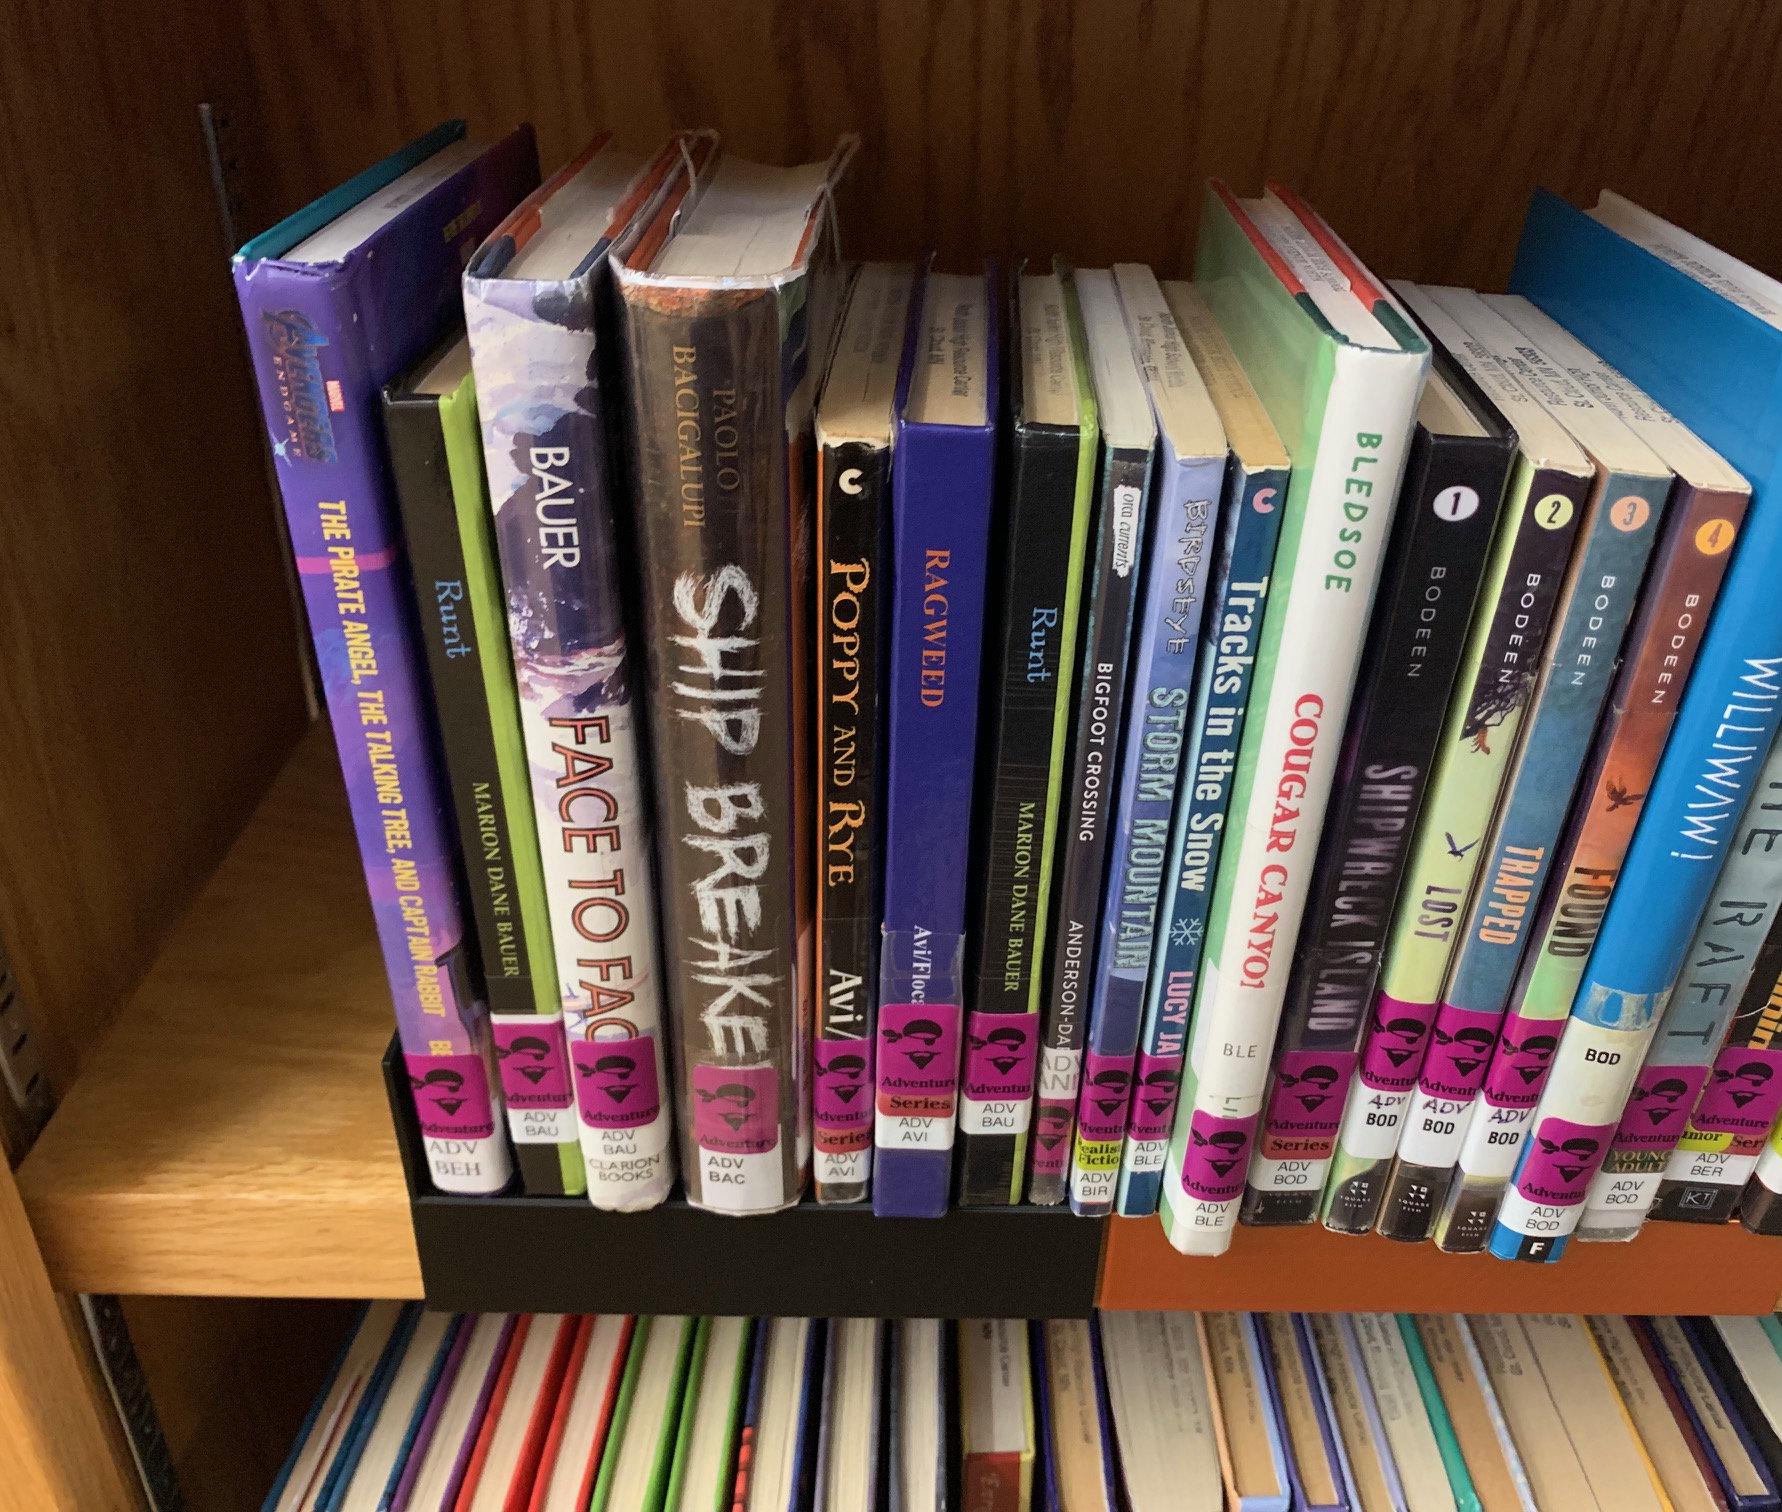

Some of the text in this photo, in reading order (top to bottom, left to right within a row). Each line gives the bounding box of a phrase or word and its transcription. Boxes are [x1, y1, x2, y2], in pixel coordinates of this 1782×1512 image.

[672, 344, 707, 528] BACIGALUPI
[712, 388, 741, 491] PAOLO
[529, 446, 581, 570] BAUER
[1450, 491, 1461, 516] 1
[1324, 432, 1383, 593] BLEDSOE
[1547, 502, 1560, 524] 2
[1623, 502, 1637, 525] 3
[1706, 526, 1722, 548] 4
[1165, 499, 1213, 655] BIRDSEYE
[435, 579, 472, 659] Runt
[1407, 566, 1446, 677] BODEEN
[1498, 572, 1541, 683] BODEEN
[920, 549, 951, 709] RAGWEED
[1570, 575, 1616, 686] BODEEN
[1026, 606, 1058, 684] Runt
[1651, 594, 1699, 704] BODEEN
[667, 564, 769, 756] SHIP
[828, 557, 870, 887] POPPY AND RYE
[1181, 576, 1269, 893] Tracks in the Snow
[318, 500, 446, 1017] THE PIRATE ANGEL, THE TALKING TREE, AND CAPTAIN RABBIT
[1079, 662, 1114, 842] BIGFOOT CROSSING
[1671, 657, 1782, 861] WILLIWAW!
[549, 714, 622, 854] FACE
[1112, 687, 1189, 970] STORM MOUNTAIN
[1240, 693, 1324, 989] COUGAR CANYO
[472, 782, 520, 978] MARION DANE BAUER
[1003, 801, 1036, 992] MARION DANE BAUER
[1307, 763, 1418, 1031] SHIPWRECK ISLAND
[1478, 845, 1545, 946] TRAPPED
[568, 868, 630, 943] TO
[1414, 884, 1463, 943] LOST
[1547, 866, 1618, 958] FOUND
[1667, 900, 1768, 1046] RAFT
[825, 968, 863, 1040] Avi/
[1162, 970, 1194, 1025] LUCY
[1223, 1044, 1258, 1058] BLE
[1584, 1048, 1621, 1065] BOD
[889, 1095, 951, 1109] Series
[982, 1103, 1017, 1113] ADV
[1368, 1094, 1406, 1109] ADV
[1422, 1098, 1471, 1114] ADV
[524, 1112, 557, 1122] ADV
[899, 1118, 933, 1128] ADV
[982, 1117, 1014, 1127] BAU
[1366, 1112, 1398, 1127] BOD
[1488, 1108, 1531, 1124] ADV
[525, 1125, 559, 1136] BAU
[602, 1130, 636, 1140] ADV
[1422, 1118, 1455, 1135] BOD
[902, 1131, 928, 1142] AVI
[1487, 1131, 1519, 1145] BOD
[429, 1141, 478, 1154] ADV
[603, 1144, 637, 1155] BAU
[1271, 1139, 1329, 1152] Series
[589, 1154, 660, 1171] CLARION
[708, 1156, 744, 1168] ADV
[824, 1153, 859, 1164] ADV
[1133, 1154, 1162, 1165] BLE
[1277, 1161, 1311, 1171] ADV
[1696, 1152, 1732, 1164] ADV
[435, 1160, 482, 1176] BEH
[599, 1168, 654, 1182] BOOKS
[829, 1166, 855, 1176] AVI
[1690, 1165, 1724, 1177] BER
[709, 1171, 745, 1185] BAC
[1080, 1173, 1114, 1183] ADV
[1274, 1174, 1308, 1185] BOD
[1611, 1181, 1645, 1191] ADV
[1081, 1186, 1108, 1196] BIR
[1605, 1194, 1639, 1204] BOD
[1196, 1202, 1230, 1214] ADV
[1531, 1206, 1566, 1218] ADV
[1194, 1215, 1225, 1227] BLE
[1525, 1219, 1560, 1231] BOD
[1529, 1242, 1545, 1255] F
